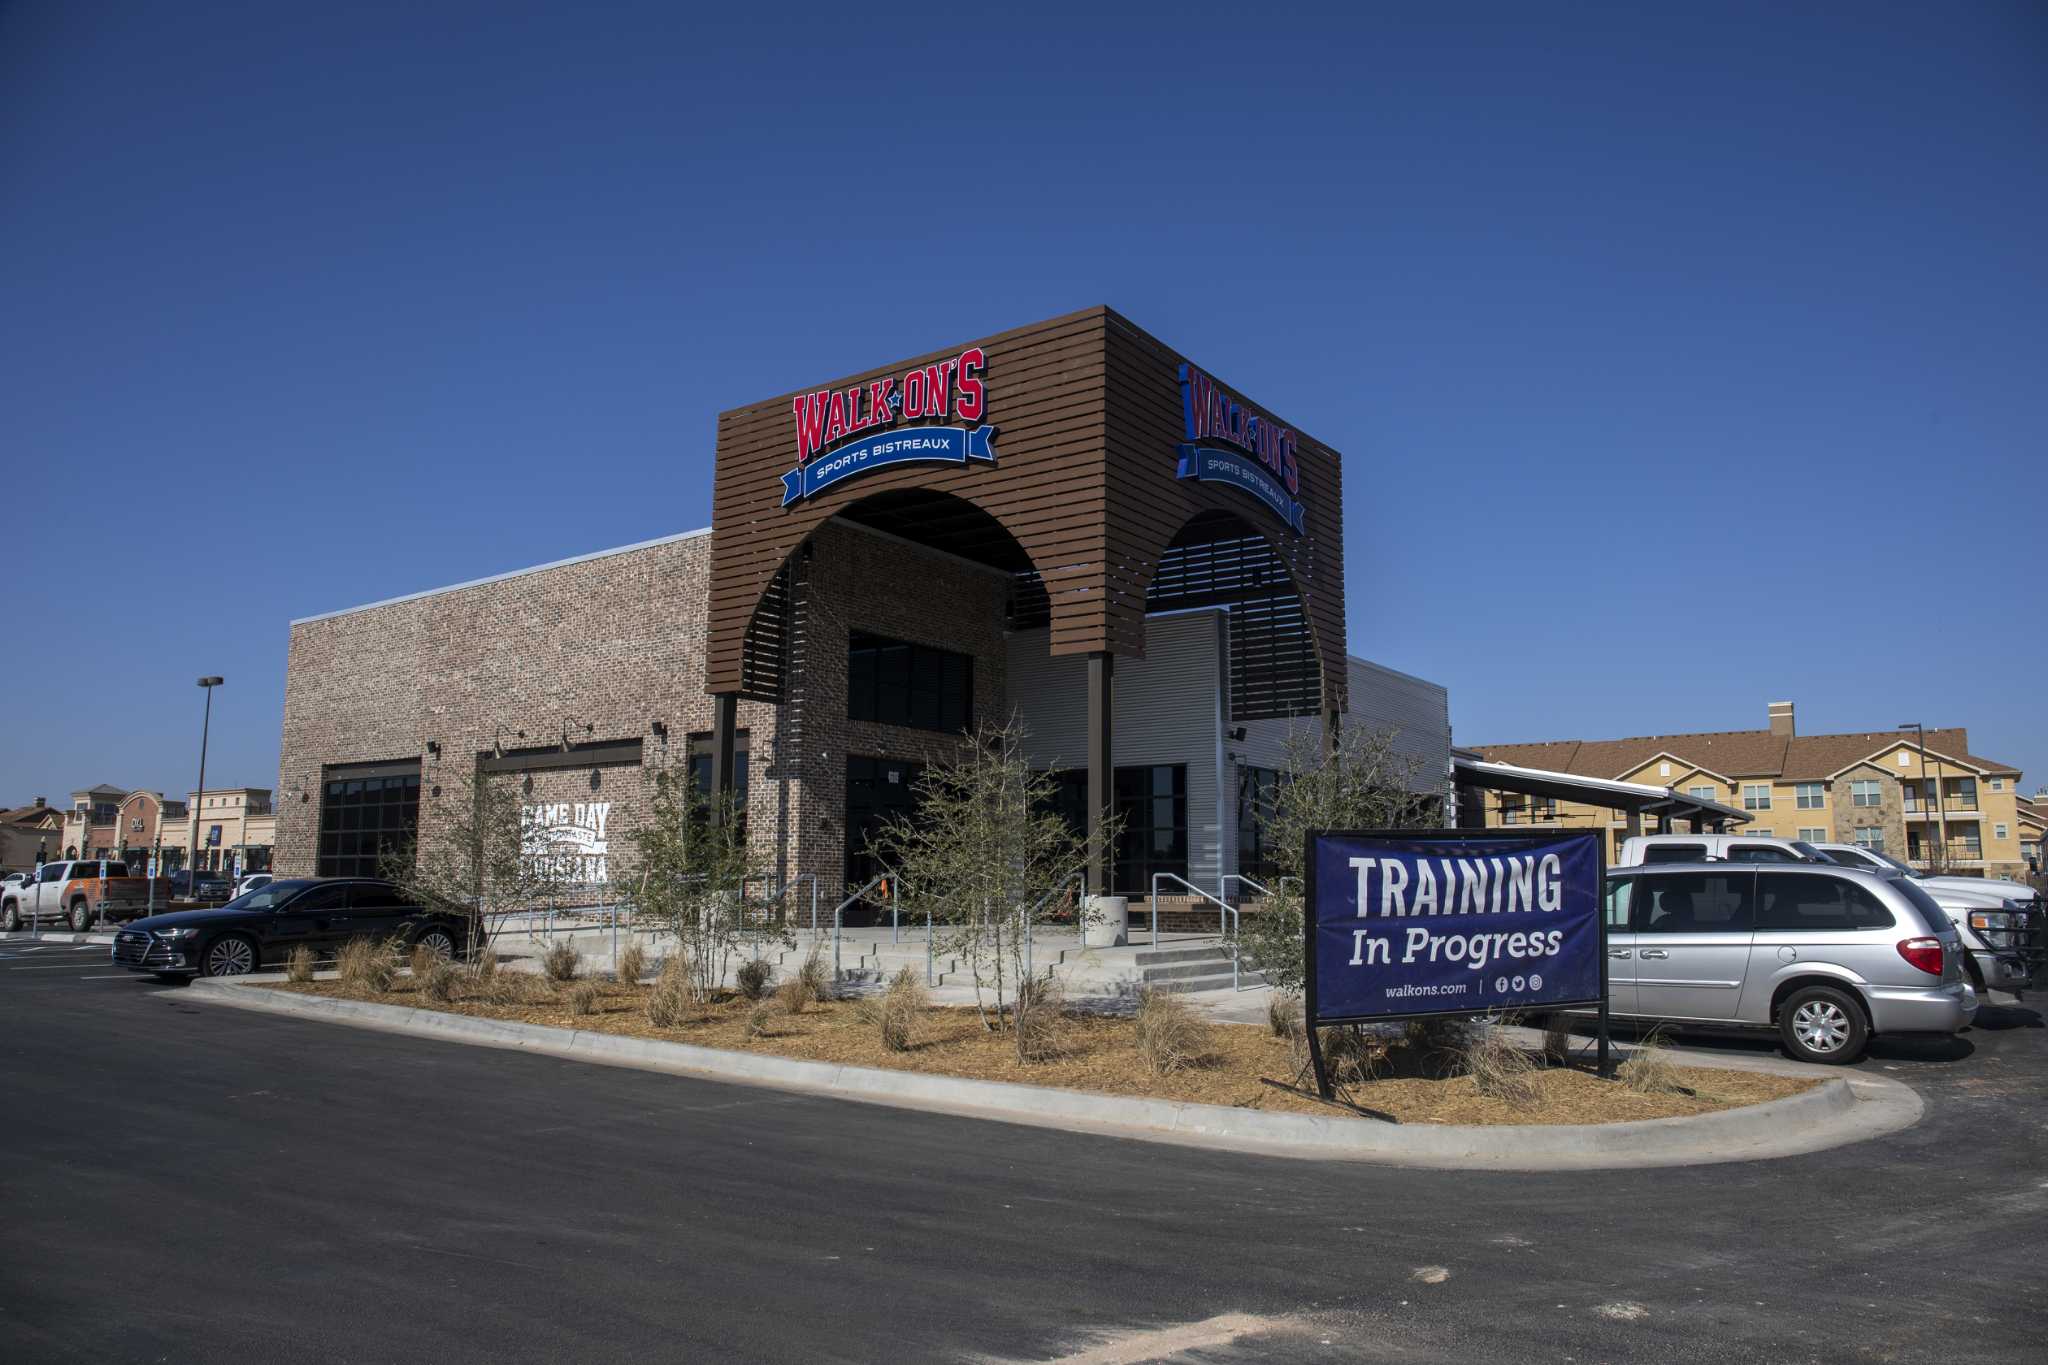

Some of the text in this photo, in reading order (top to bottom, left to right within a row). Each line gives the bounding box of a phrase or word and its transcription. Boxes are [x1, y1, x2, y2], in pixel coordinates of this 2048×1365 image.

[793, 348, 985, 463] WALK ON'S
[1184, 365, 1253, 451] WALK
[816, 439, 950, 479] SPORTS BISTREAUX
[1208, 459, 1285, 507] SPORTS BISTREAUX
[574, 802, 610, 839] DAY
[1349, 853, 1562, 918] TRAINING
[1349, 928, 1563, 969] In Progress
[1385, 983, 1467, 999] walkons.com
